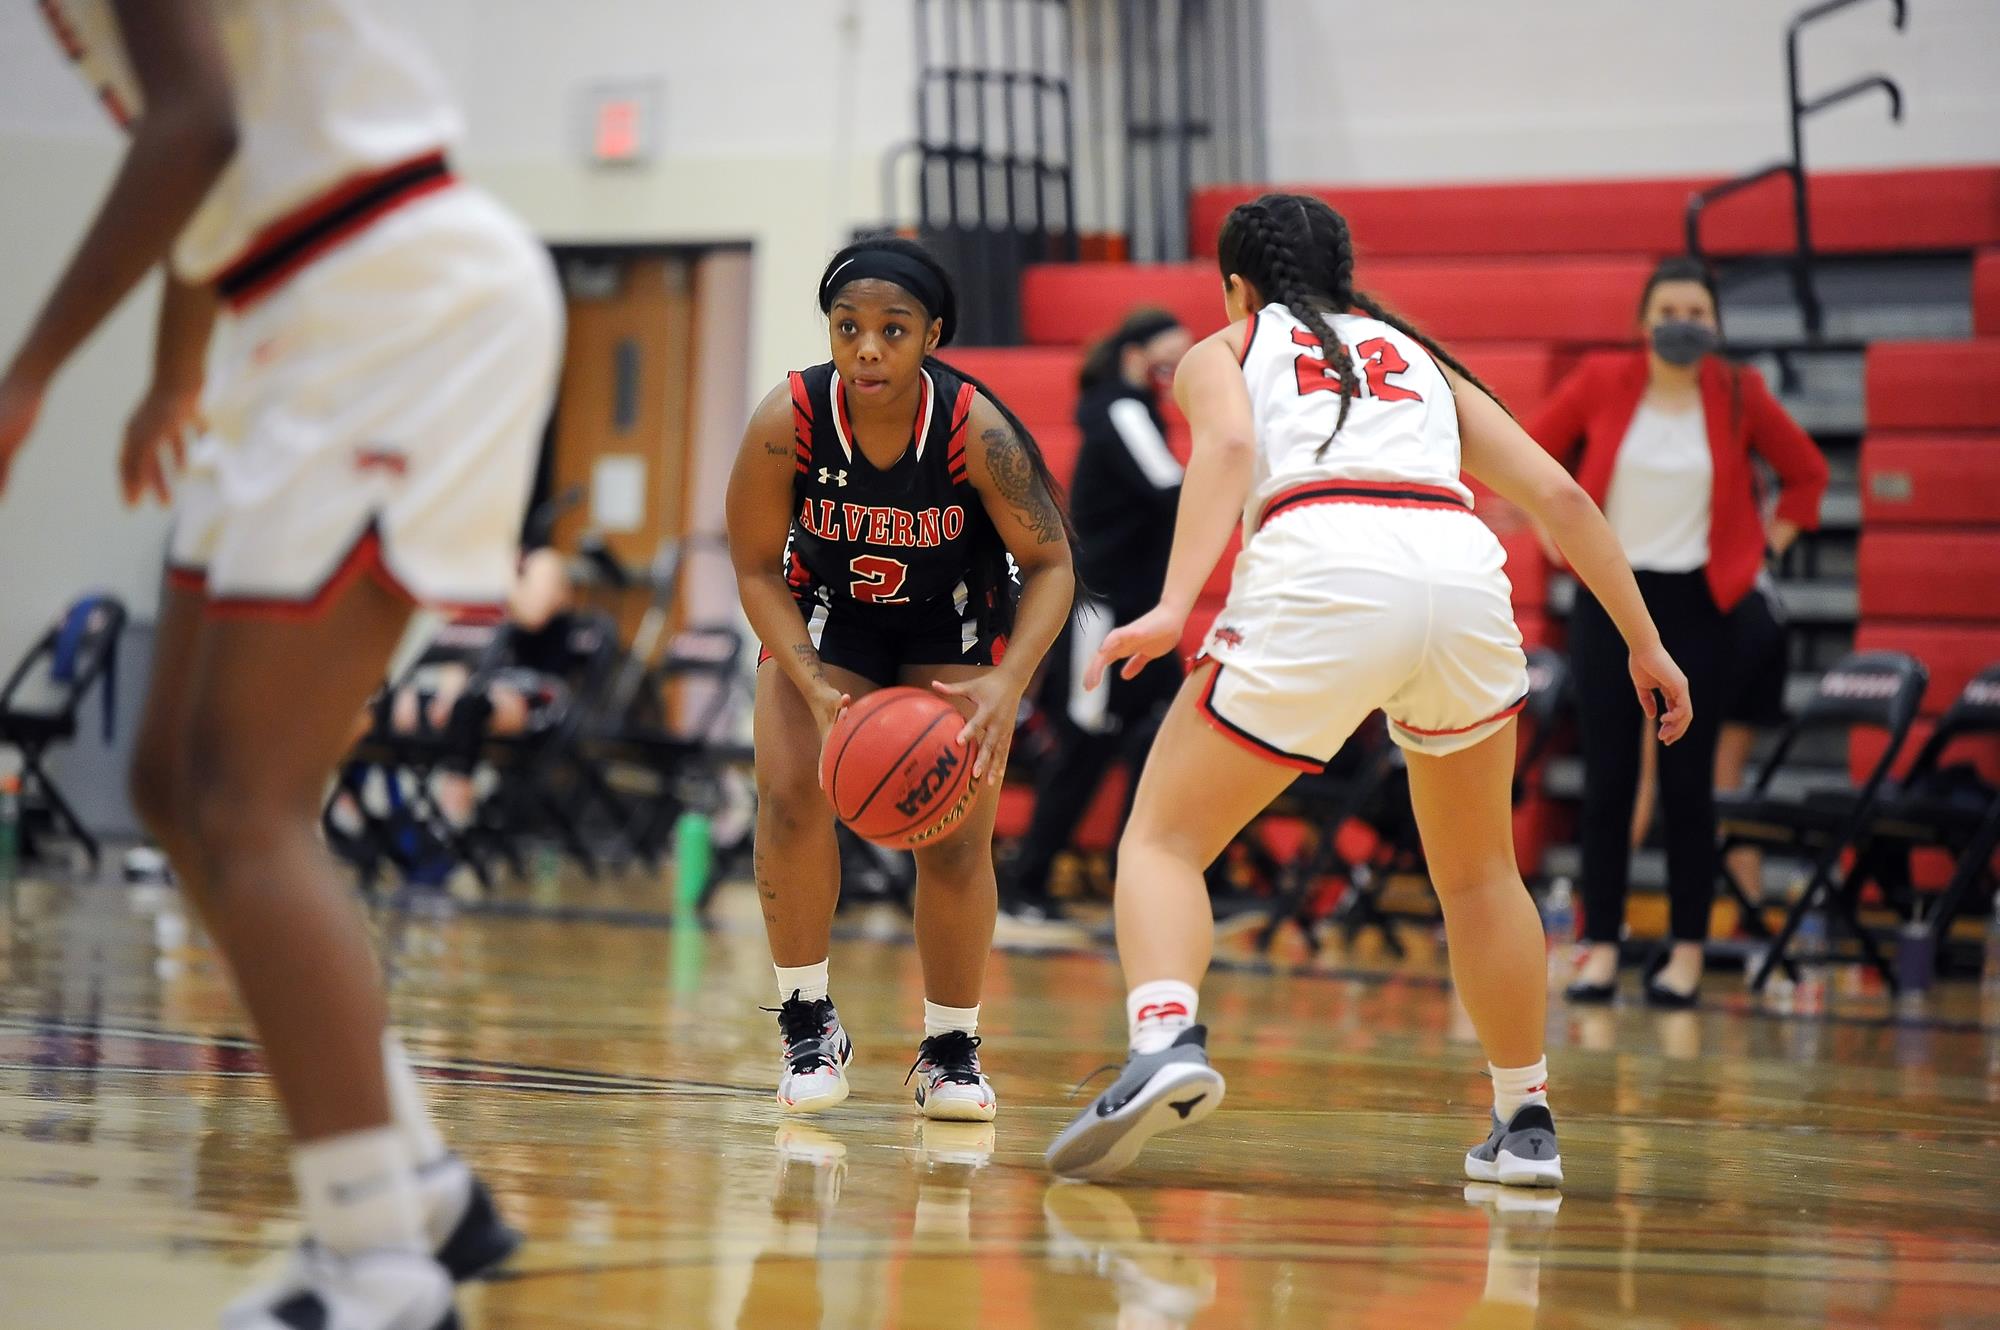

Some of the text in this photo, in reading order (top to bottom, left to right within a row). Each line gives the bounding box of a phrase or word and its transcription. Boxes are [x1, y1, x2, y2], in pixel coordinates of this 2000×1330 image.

[1291, 325, 1424, 402] 22
[800, 497, 964, 548] ALVERNO
[849, 554, 910, 604] 2
[896, 745, 958, 817] NCAA
